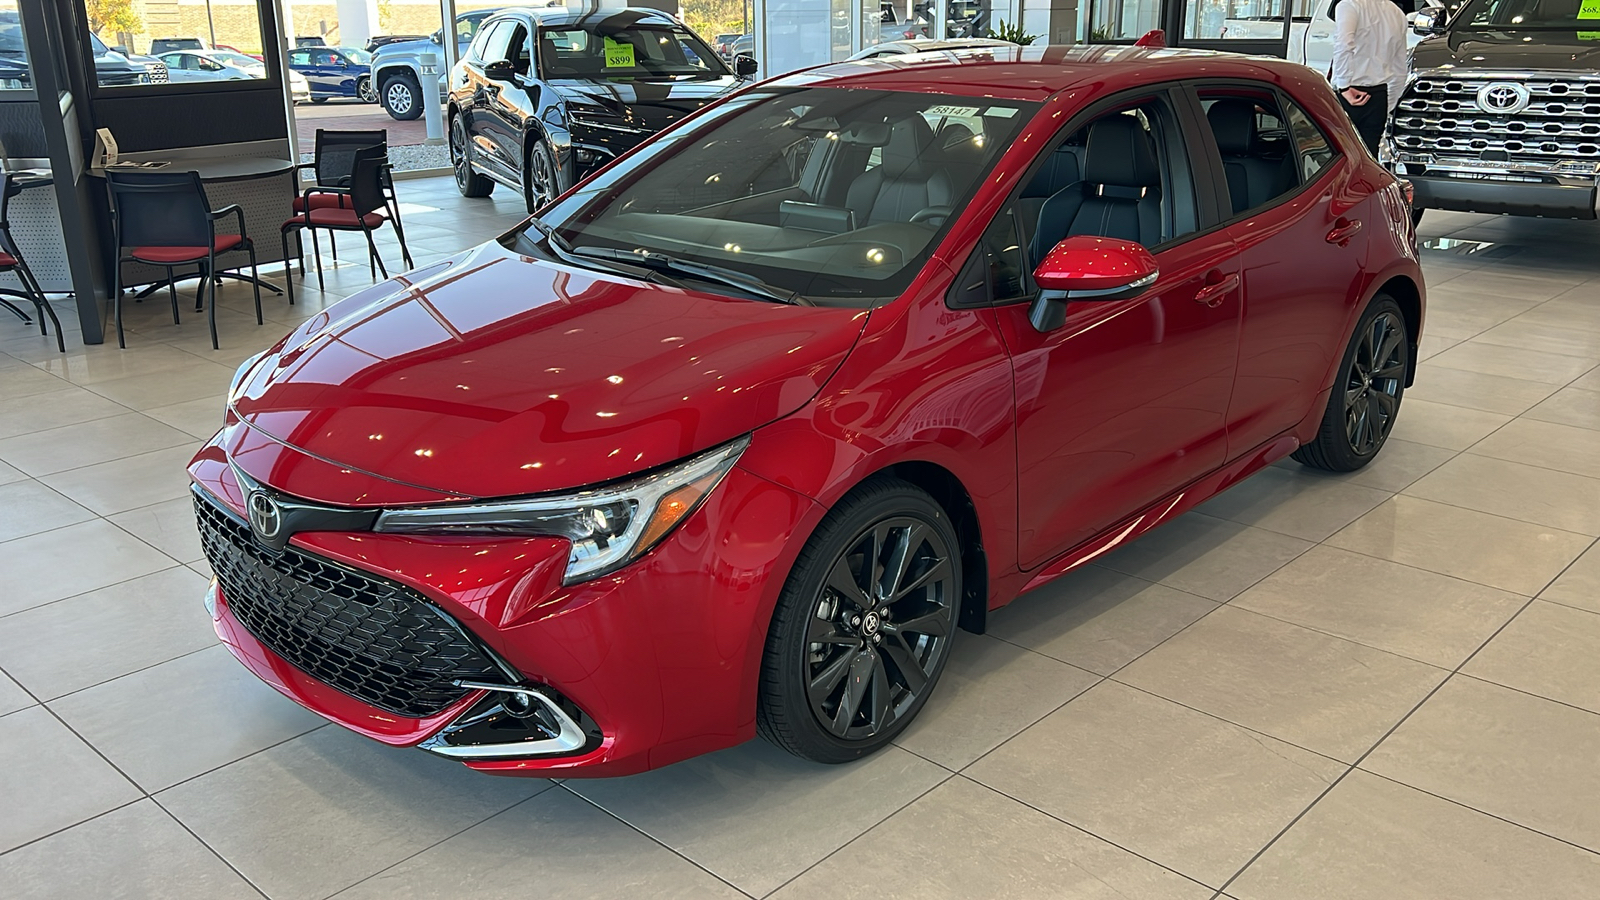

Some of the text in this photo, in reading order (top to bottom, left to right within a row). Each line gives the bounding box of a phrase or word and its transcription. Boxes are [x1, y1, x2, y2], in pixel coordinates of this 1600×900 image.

[1582, 6, 1600, 14] $68,
[610, 55, 631, 65] $899
[933, 106, 971, 116] 58147
